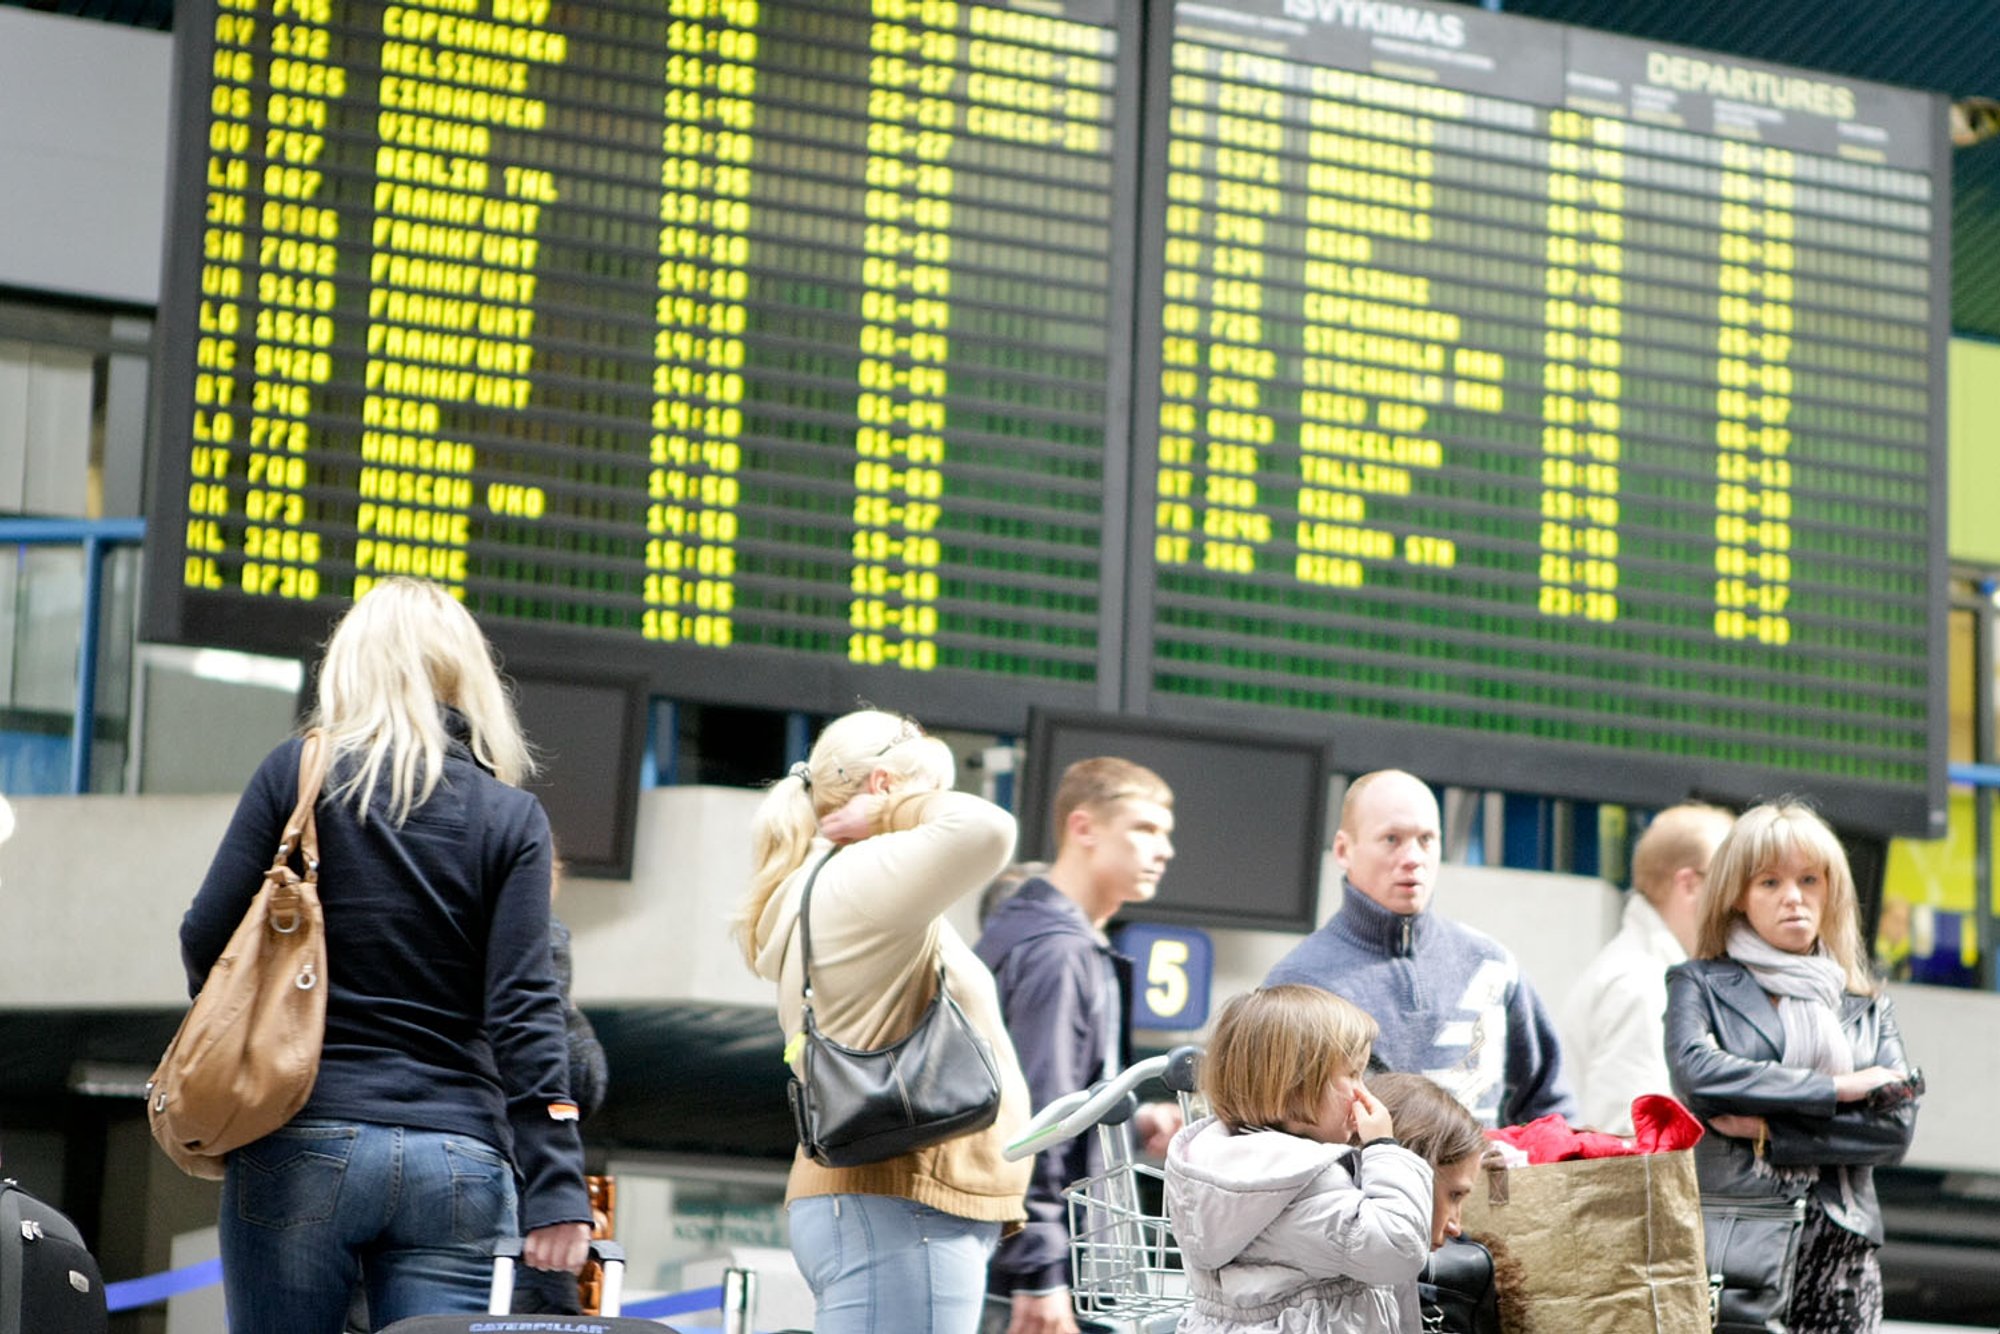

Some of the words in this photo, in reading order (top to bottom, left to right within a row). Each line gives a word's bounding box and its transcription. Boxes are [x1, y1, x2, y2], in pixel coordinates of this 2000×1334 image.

[272, 24, 328, 58] 132
[382, 42, 526, 91] HELSINKI
[1646, 51, 1857, 120] DEPARTURES
[379, 112, 489, 155] VIENNA
[377, 147, 487, 190] BERLIN
[375, 182, 539, 233] FRANKFURT
[373, 218, 538, 268] FRANKFURT
[371, 254, 535, 303] FRANKFURT
[369, 289, 533, 338] FRANKFURT
[368, 325, 532, 373] FRANKFURT
[366, 360, 530, 409] FRANKFURT
[362, 432, 473, 472] WARSAW
[360, 468, 471, 508] MOSCOW
[358, 504, 468, 544] PRAGUE
[356, 540, 466, 580] PRAGUE
[1144, 939, 1189, 1018] 5
[469, 1322, 604, 1334] CATERPILLAR
